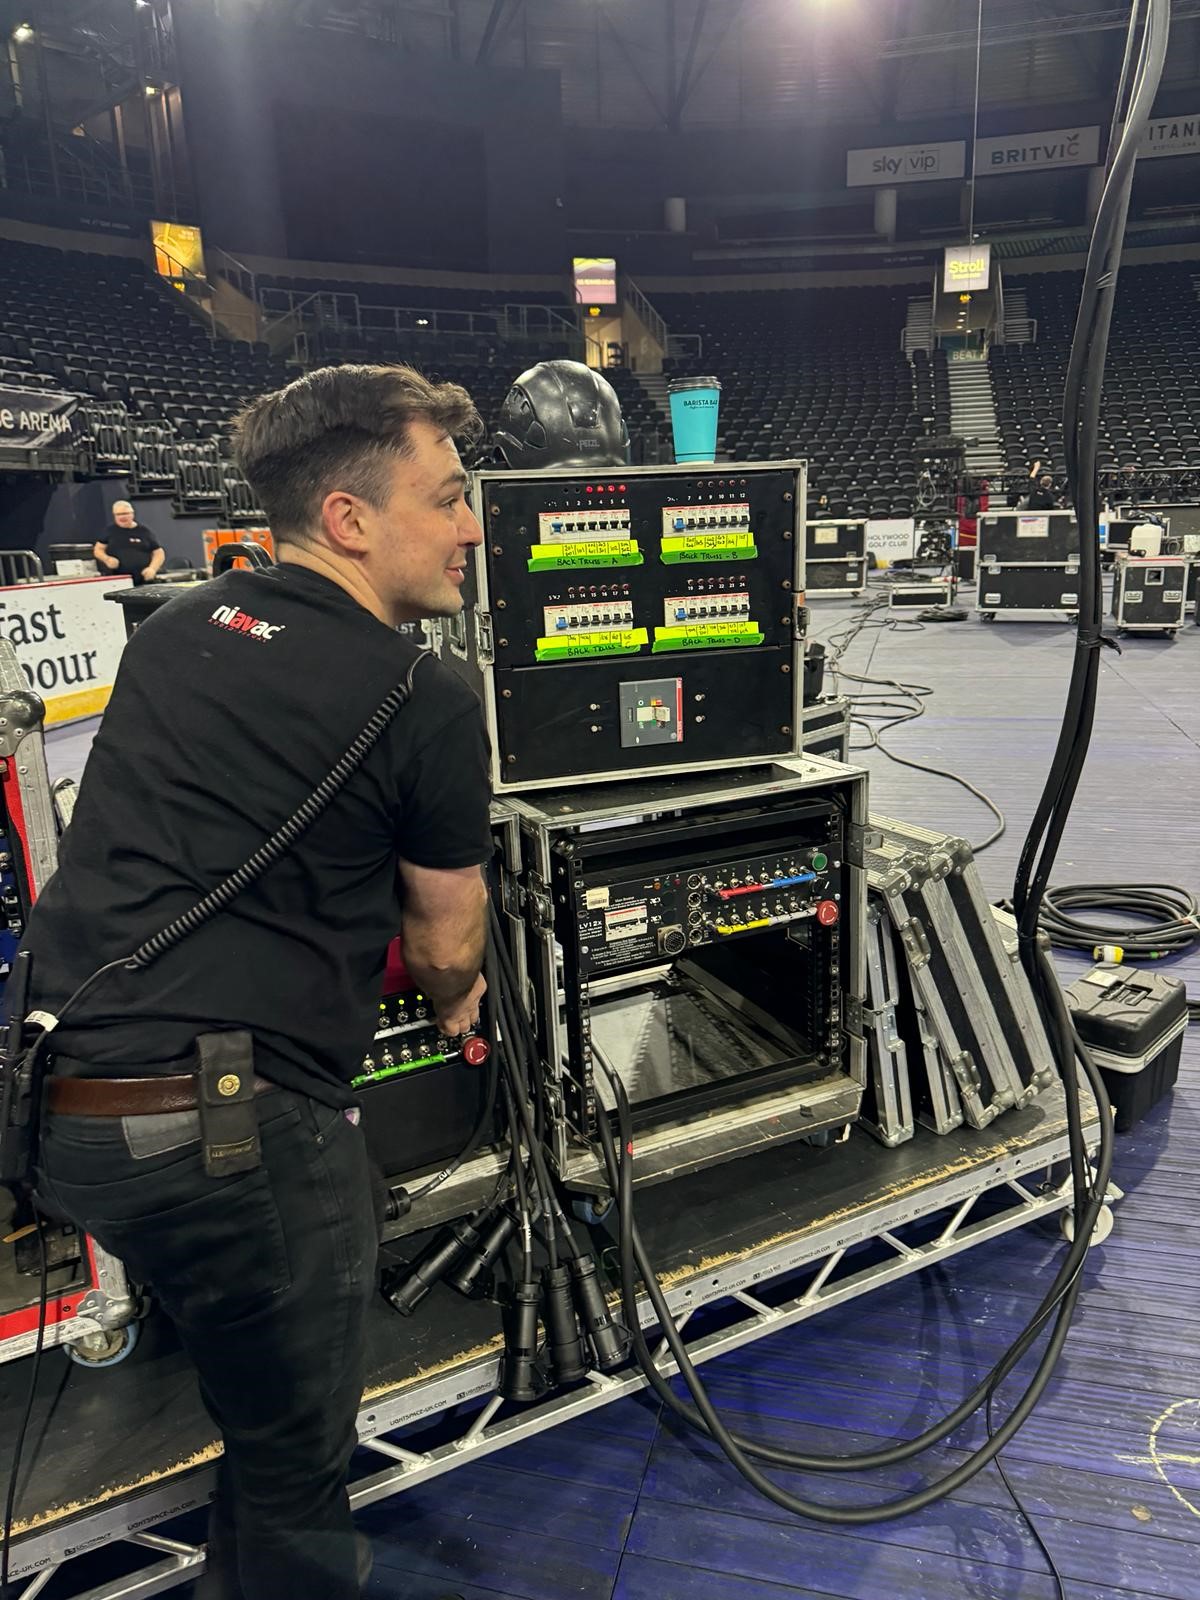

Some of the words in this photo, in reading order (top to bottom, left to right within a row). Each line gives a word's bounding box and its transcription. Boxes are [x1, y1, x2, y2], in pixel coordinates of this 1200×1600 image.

[872, 155, 902, 175] sky
[909, 150, 936, 171] vip
[949, 258, 985, 274] Stroll
[683, 399, 709, 407] BARISTA
[20, 410, 73, 433] ARENA
[868, 541, 887, 549] GOLF
[612, 556, 618, 564] A
[211, 604, 282, 640] niavac
[567, 647, 590, 657] BACK
[6, 1557, 52, 1579] ACE-UK.COM
